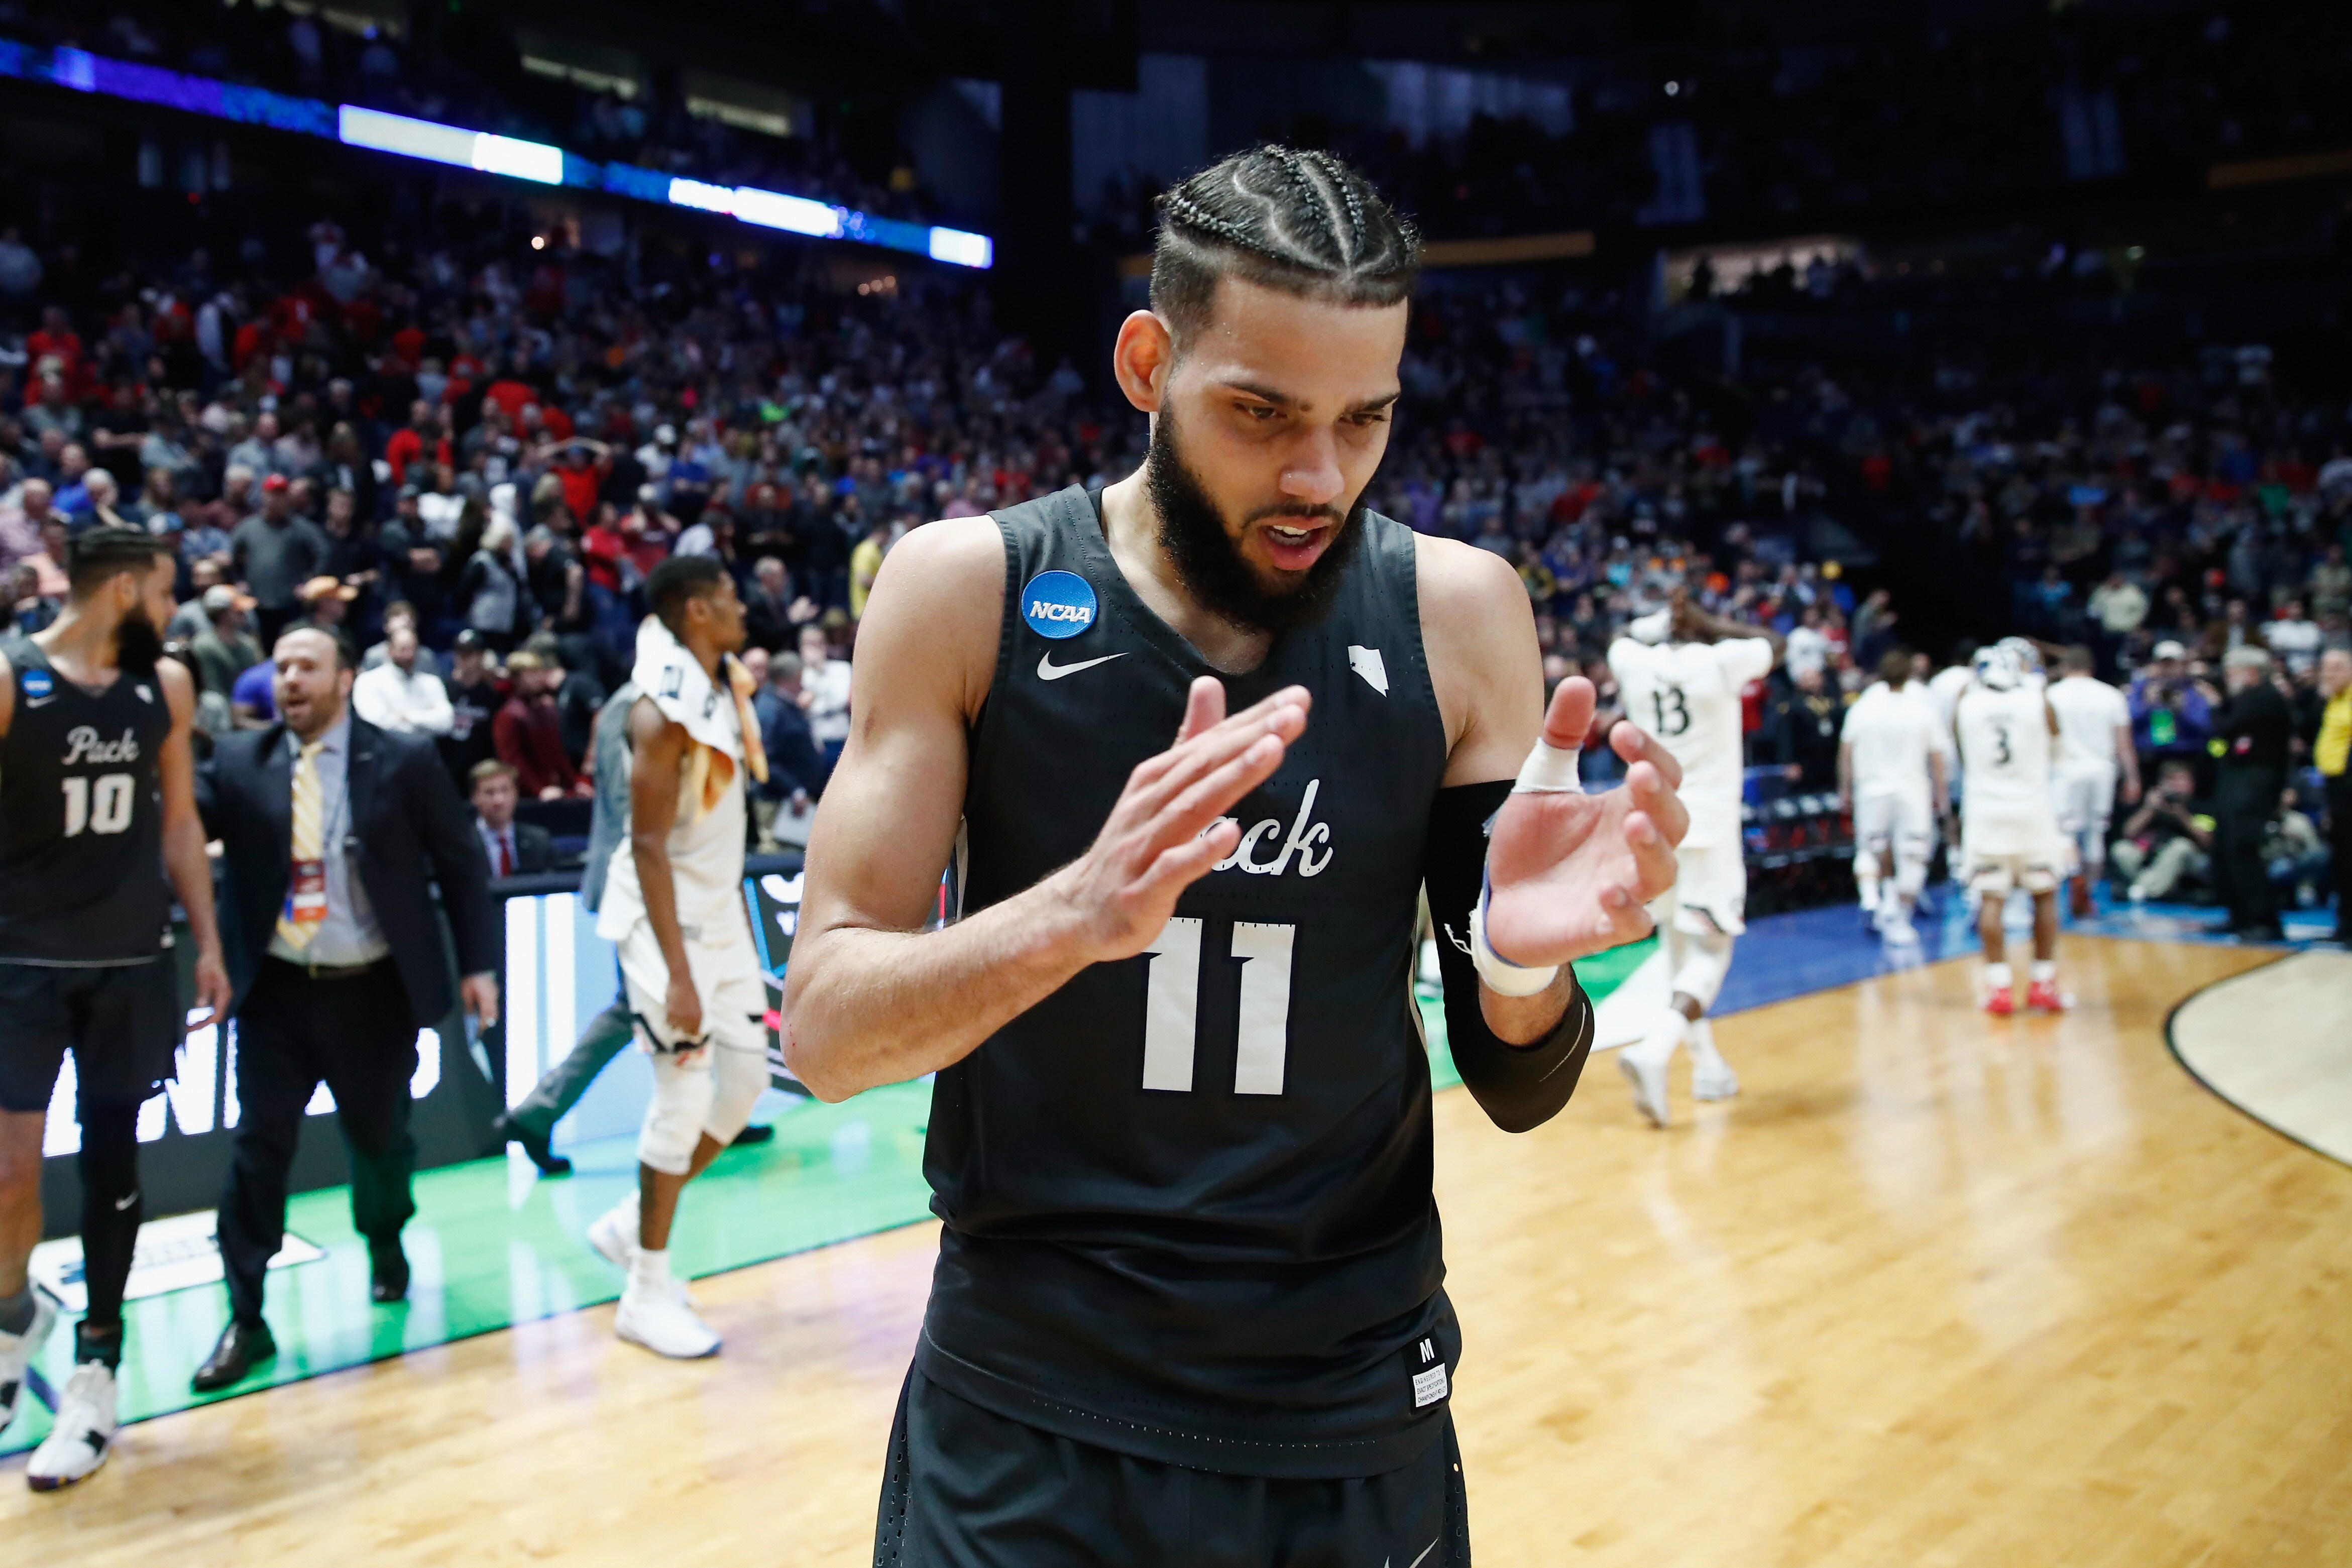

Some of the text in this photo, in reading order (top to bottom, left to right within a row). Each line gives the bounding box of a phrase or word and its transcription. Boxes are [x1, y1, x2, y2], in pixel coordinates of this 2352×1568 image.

[1030, 600, 1091, 623] NCAA
[1652, 685, 1691, 736] 13
[61, 725, 140, 765] Pack
[1992, 725, 2012, 769] 3
[61, 772, 136, 838] 10
[1198, 779, 1333, 877] ack
[1141, 916, 1296, 1095] 11
[1419, 1338, 1435, 1363] M
